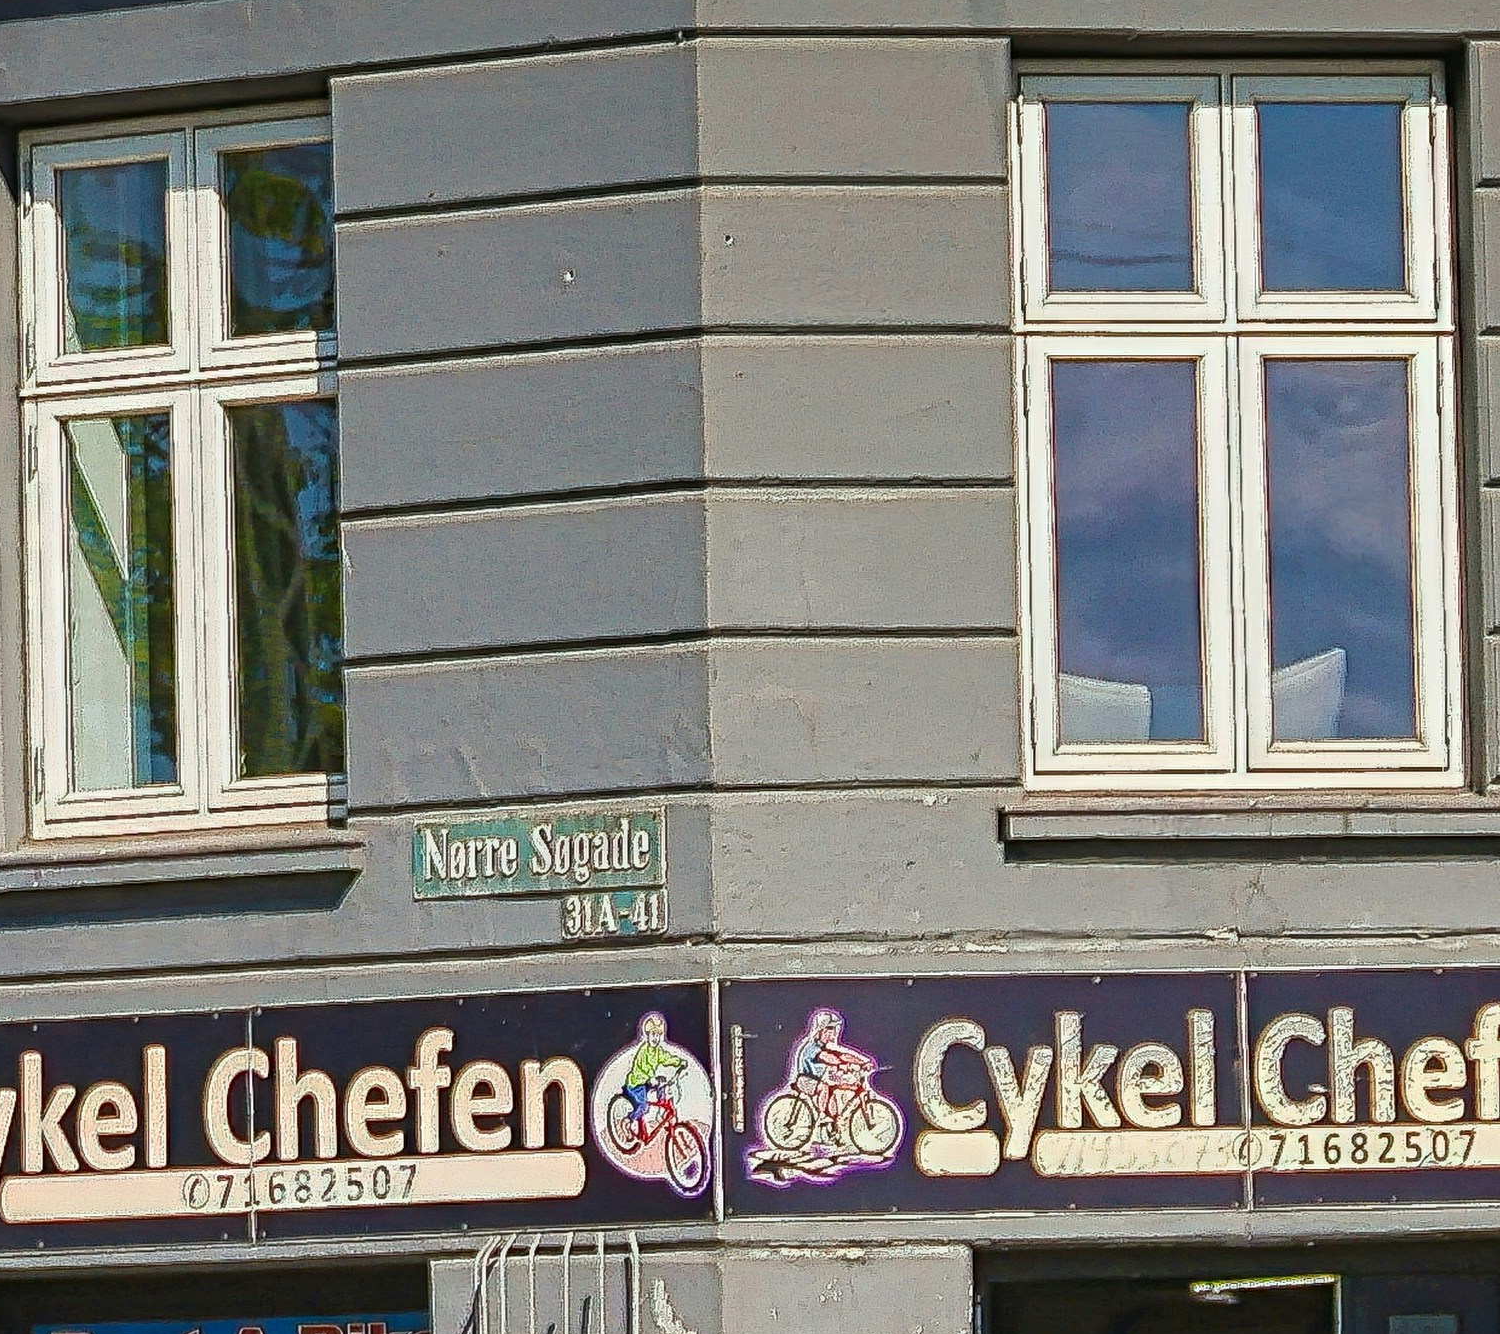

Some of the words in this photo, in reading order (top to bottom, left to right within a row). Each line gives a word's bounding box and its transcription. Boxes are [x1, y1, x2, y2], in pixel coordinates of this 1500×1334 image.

[423, 829, 518, 881] Nørre
[529, 818, 650, 884] Søgade
[565, 892, 660, 934] 31A-41
[203, 1026, 587, 1166] Chefen
[913, 1008, 1215, 1161] Cykel
[1268, 1130, 1478, 1168] 71682507
[216, 1164, 417, 1210] 71682507
